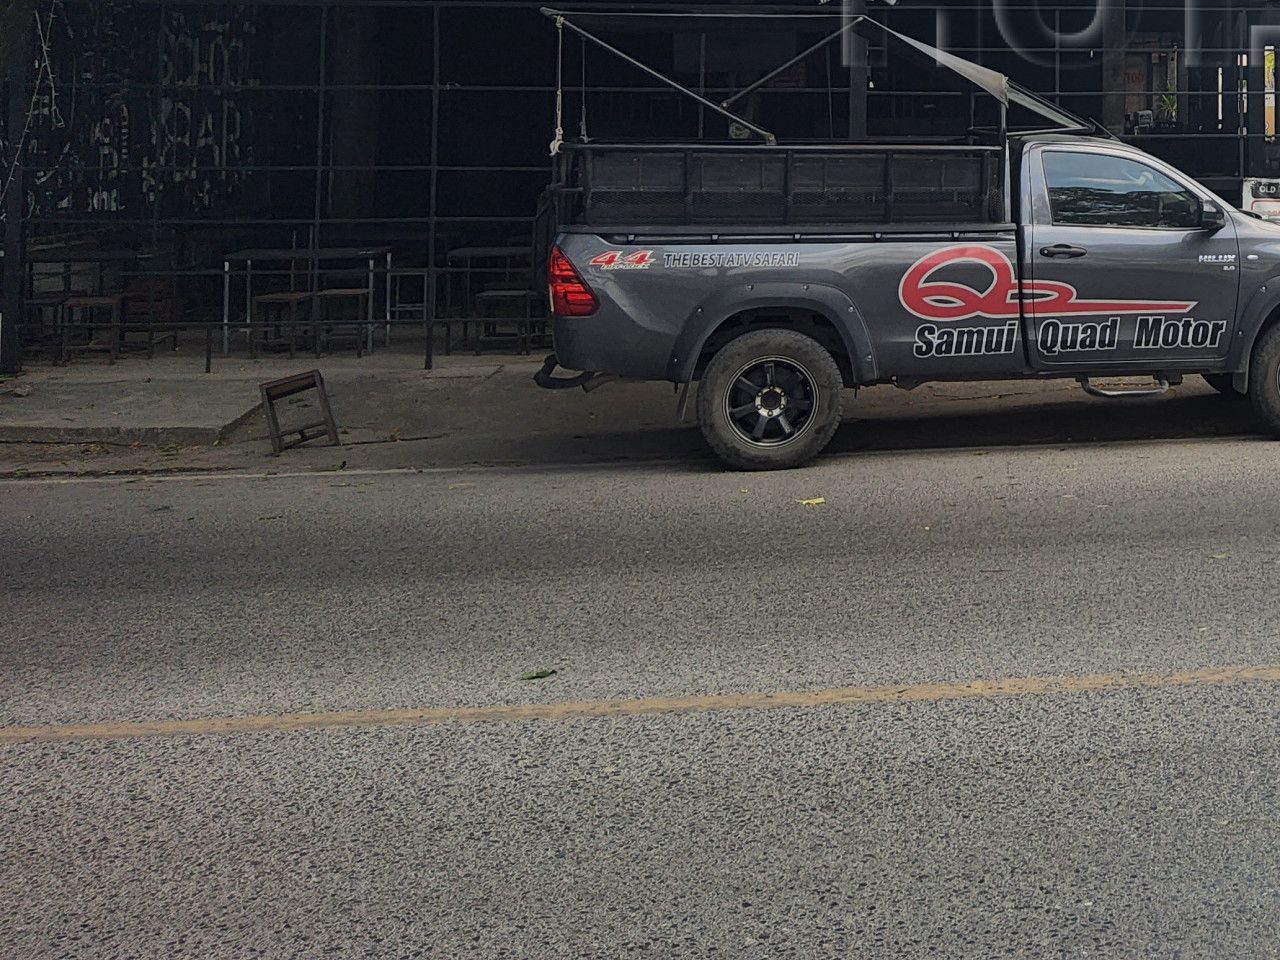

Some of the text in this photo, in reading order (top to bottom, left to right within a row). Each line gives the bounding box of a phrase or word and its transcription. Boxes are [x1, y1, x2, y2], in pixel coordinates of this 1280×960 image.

[1260, 185, 1276, 193] OLD
[663, 252, 690, 268] THE
[690, 252, 724, 267] BEST
[725, 252, 754, 267] ATV
[754, 251, 800, 267] SAFARI
[913, 316, 1227, 358] Samui Quad Motor
